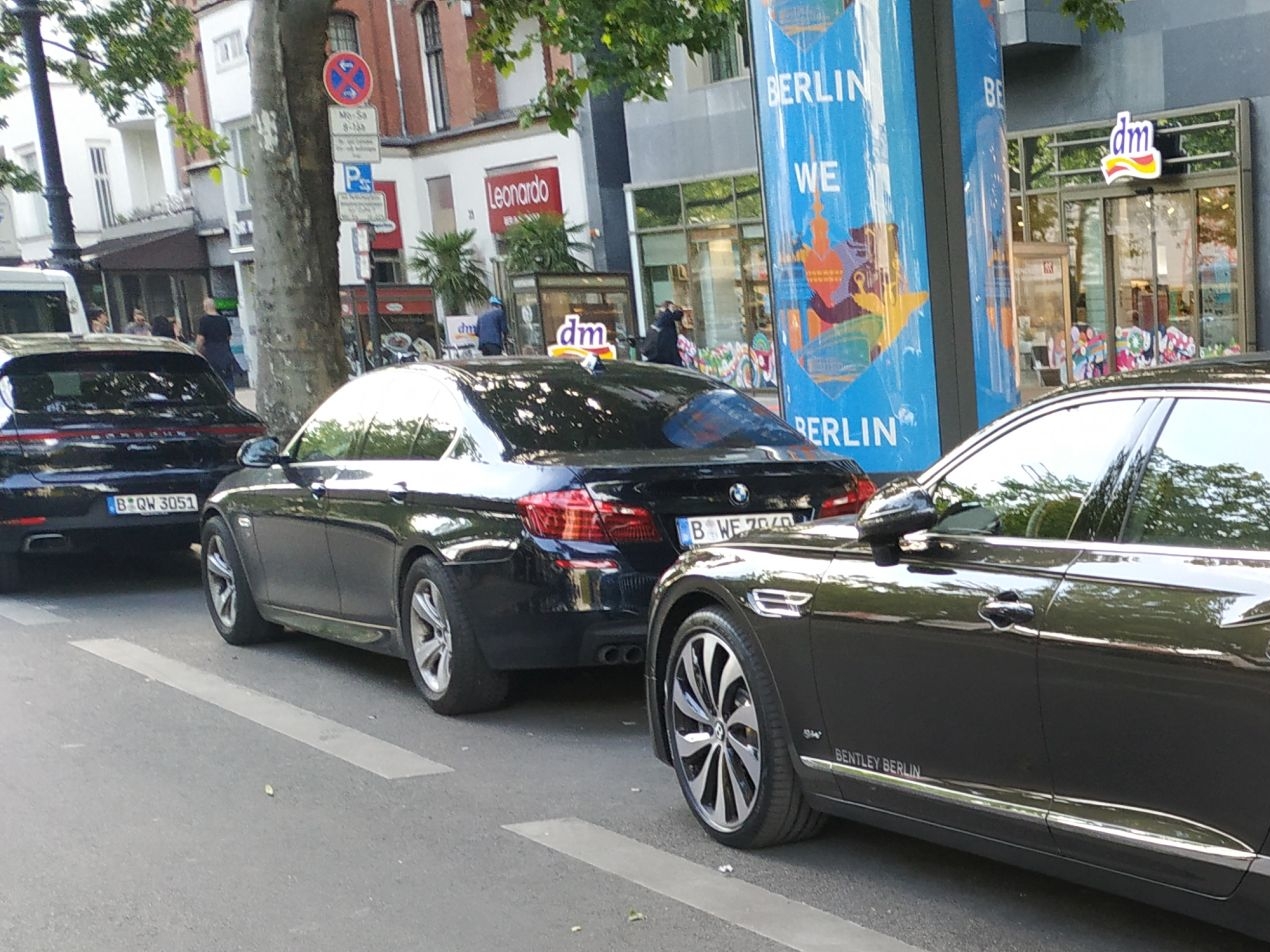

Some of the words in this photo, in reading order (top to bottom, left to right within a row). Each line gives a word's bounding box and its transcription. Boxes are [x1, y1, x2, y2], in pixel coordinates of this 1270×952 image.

[767, 69, 870, 107] BERLIN
[1113, 117, 1148, 155] dm
[345, 166, 361, 191] P
[488, 174, 549, 209] Leonardo
[794, 161, 840, 194] WE
[561, 319, 604, 346] dm
[795, 416, 897, 447] BERLIN
[117, 500, 127, 512] B
[137, 497, 156, 511] QW
[160, 496, 196, 510] 3051
[691, 520, 705, 540] B
[835, 748, 881, 770] BENTLEY
[882, 758, 921, 779] BERLIN
